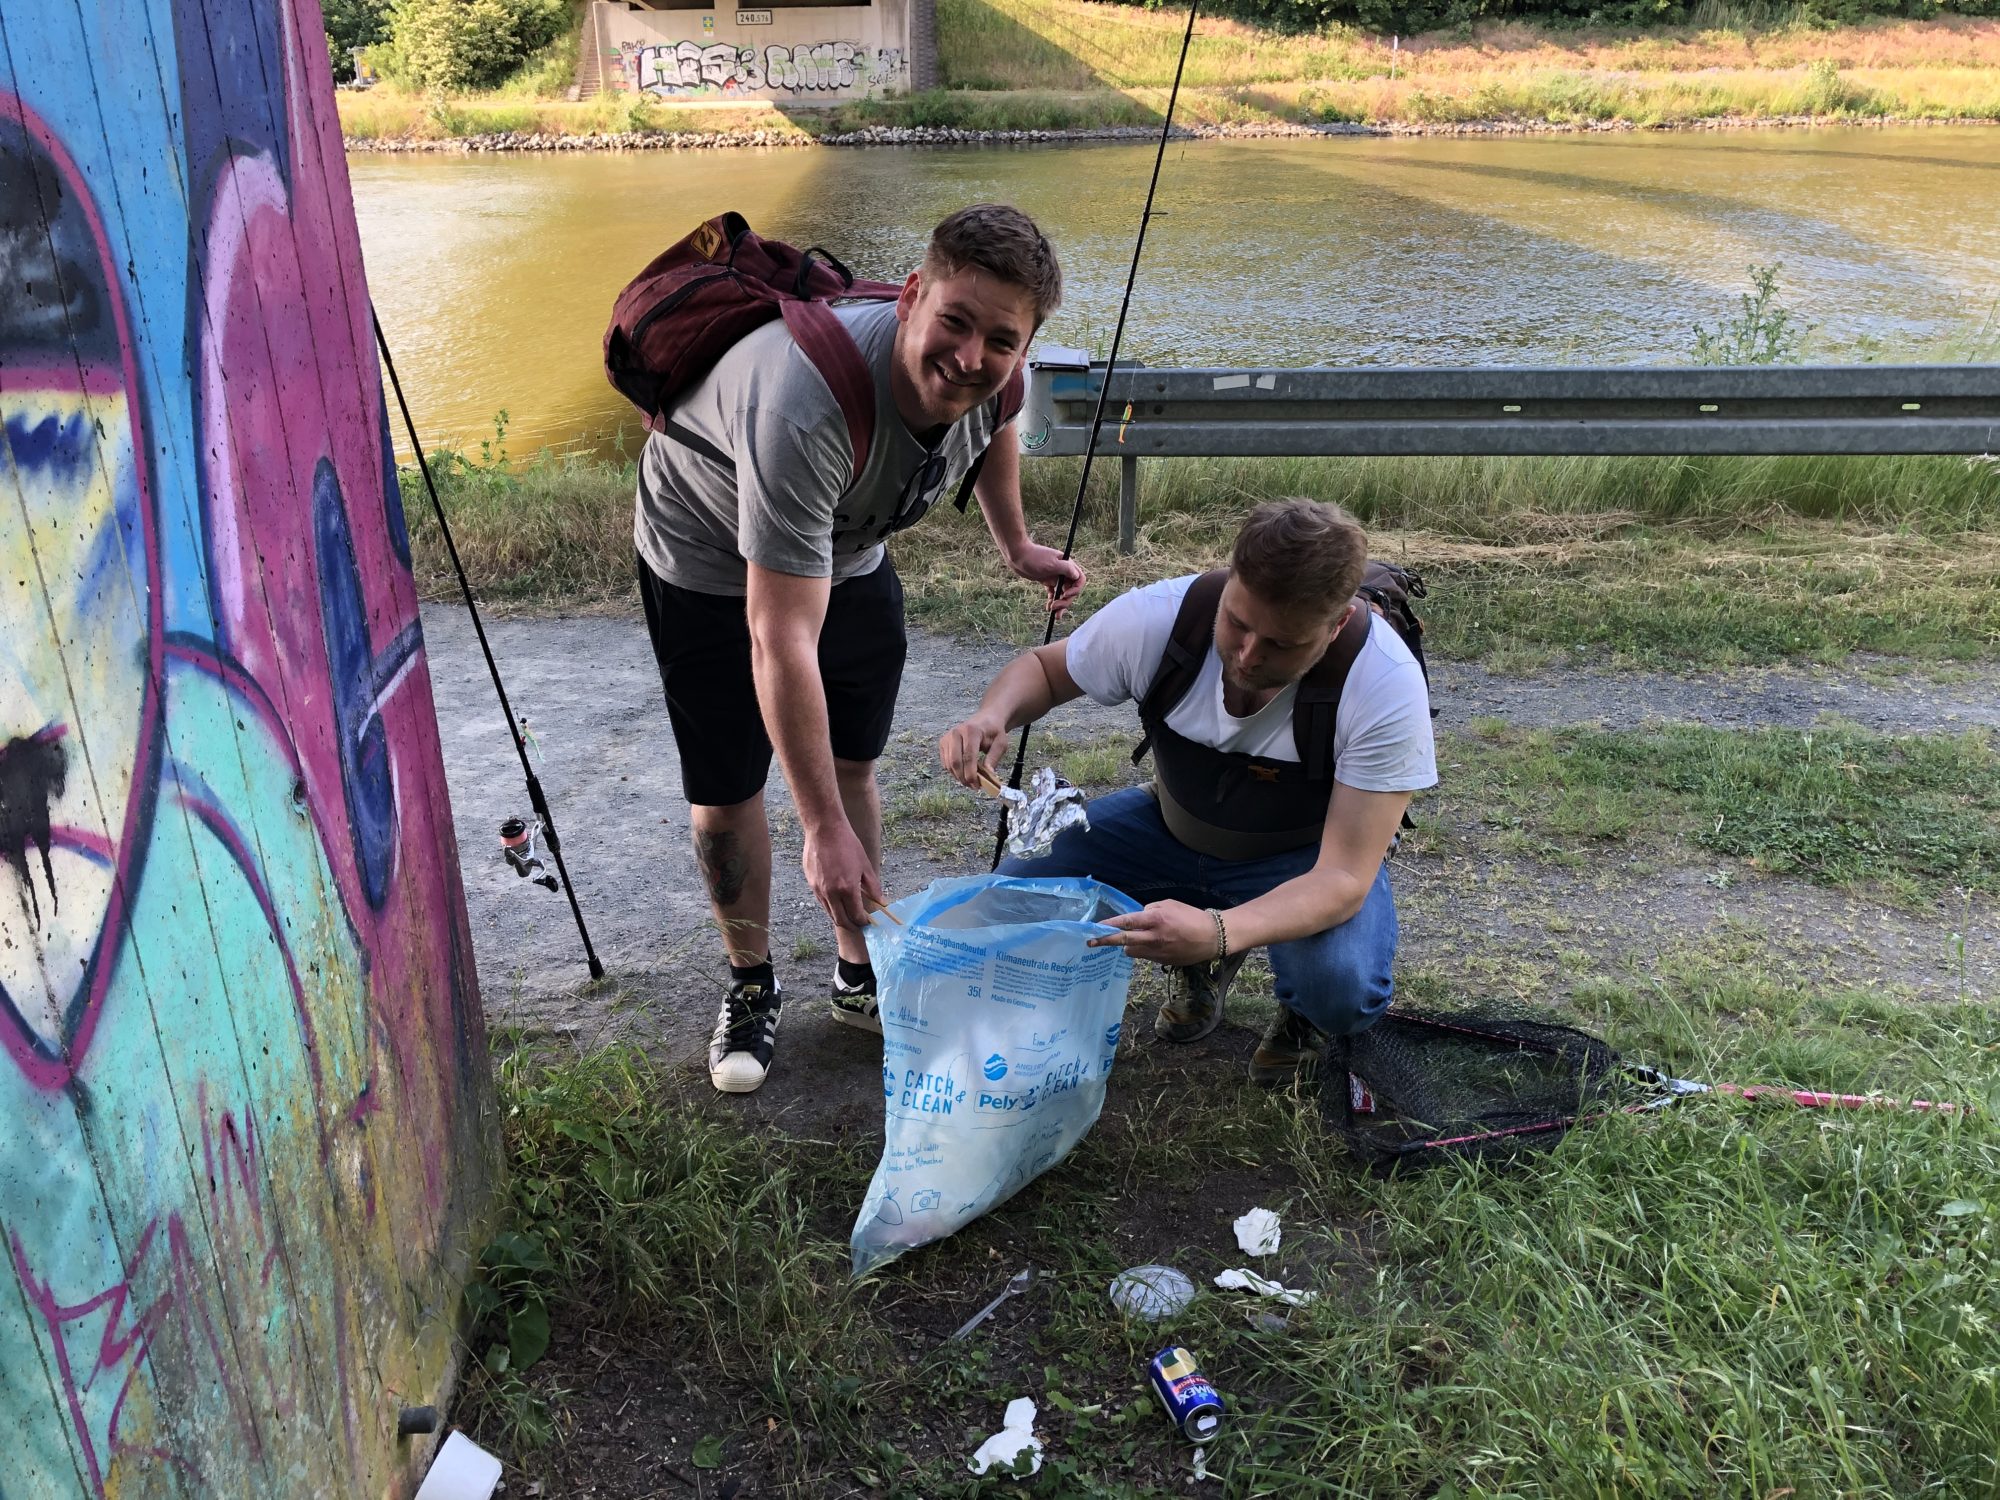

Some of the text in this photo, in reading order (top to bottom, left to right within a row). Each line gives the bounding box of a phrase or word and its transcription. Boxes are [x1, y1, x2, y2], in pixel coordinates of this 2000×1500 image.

[996, 950, 1050, 971] Klimaneutrale
[904, 1069, 966, 1103] CATCH &
[901, 1090, 953, 1115] CLEAN
[979, 1093, 1019, 1111] Pely
